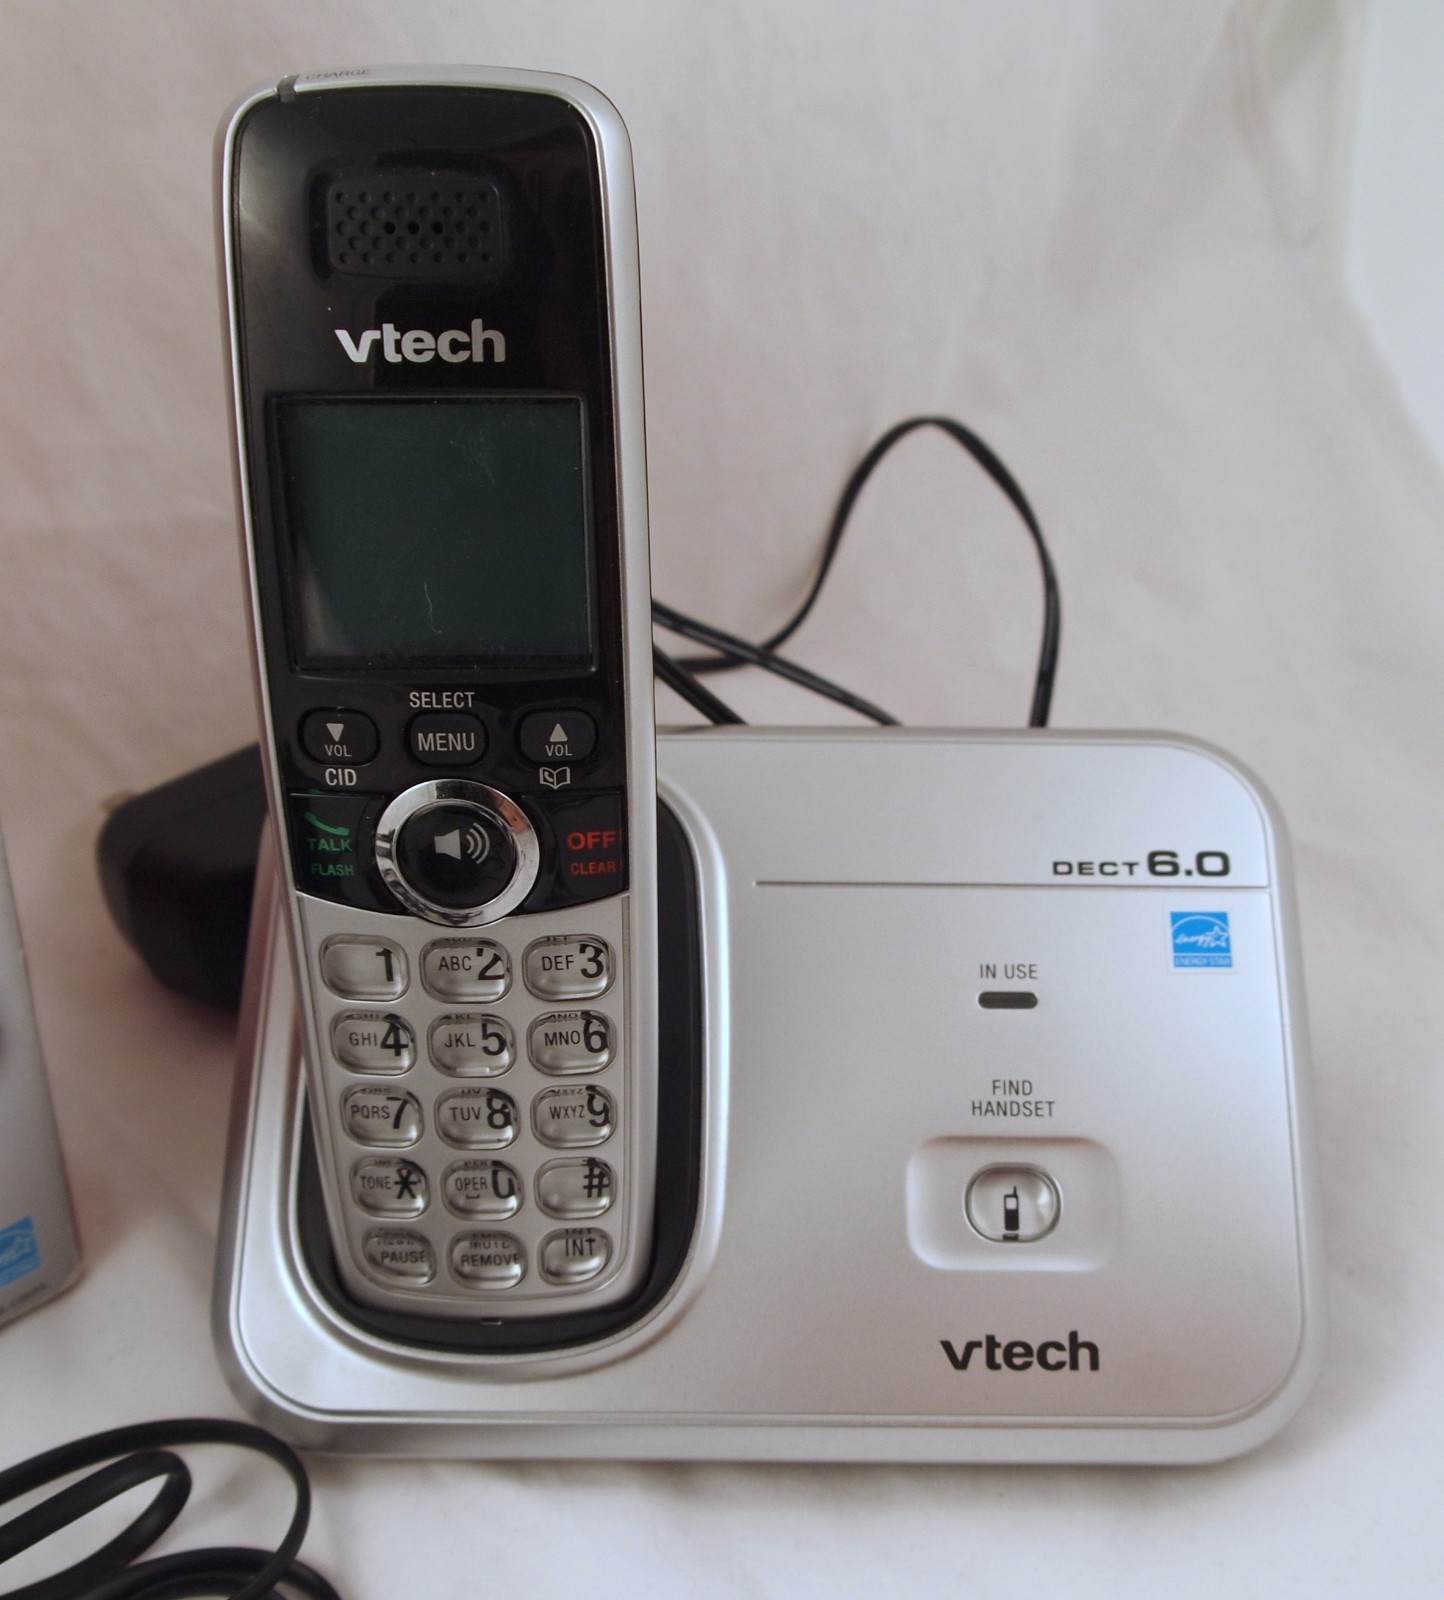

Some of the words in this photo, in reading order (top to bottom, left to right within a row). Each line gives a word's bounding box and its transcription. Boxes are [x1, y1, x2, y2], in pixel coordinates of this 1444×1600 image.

[306, 69, 371, 81] CHARGE
[334, 318, 506, 363] vtech
[409, 691, 475, 708] SELECT
[324, 744, 352, 757] VOL
[417, 732, 475, 751] MENU
[545, 744, 572, 757] VOL
[325, 767, 357, 787] CID
[307, 838, 352, 851] TALK
[567, 831, 617, 850] OFF
[311, 863, 354, 876] FLASH
[570, 861, 616, 875] CLEAR
[1053, 861, 1139, 876] DECT
[1147, 850, 1230, 877] 6.0
[375, 947, 394, 982] 1
[438, 955, 472, 971] ABC
[476, 947, 505, 981] 2
[542, 954, 574, 971] DEF
[579, 943, 604, 979] 3
[980, 963, 997, 980] IN
[1004, 963, 1038, 980] USE
[349, 1032, 378, 1047] GHI
[381, 1016, 409, 1056] 4
[444, 1032, 475, 1048] JKL
[481, 1018, 506, 1056] 5
[544, 1030, 580, 1047] MNO
[583, 1016, 608, 1054] 6
[992, 1079, 1033, 1096] FIND
[352, 1104, 390, 1119] PQRS
[386, 1095, 409, 1129] 7
[449, 1106, 482, 1121] TUV
[486, 1091, 512, 1130] 8
[549, 1104, 585, 1119] WXYZ
[586, 1091, 611, 1127] 9
[972, 1100, 1056, 1117] HANDSET
[360, 1175, 391, 1190] TONE
[455, 1176, 488, 1191] OPER
[565, 1236, 596, 1256] INT
[381, 1250, 427, 1264] PAUSE
[461, 1253, 519, 1267] REMOVE
[939, 1330, 1099, 1371] vtech
